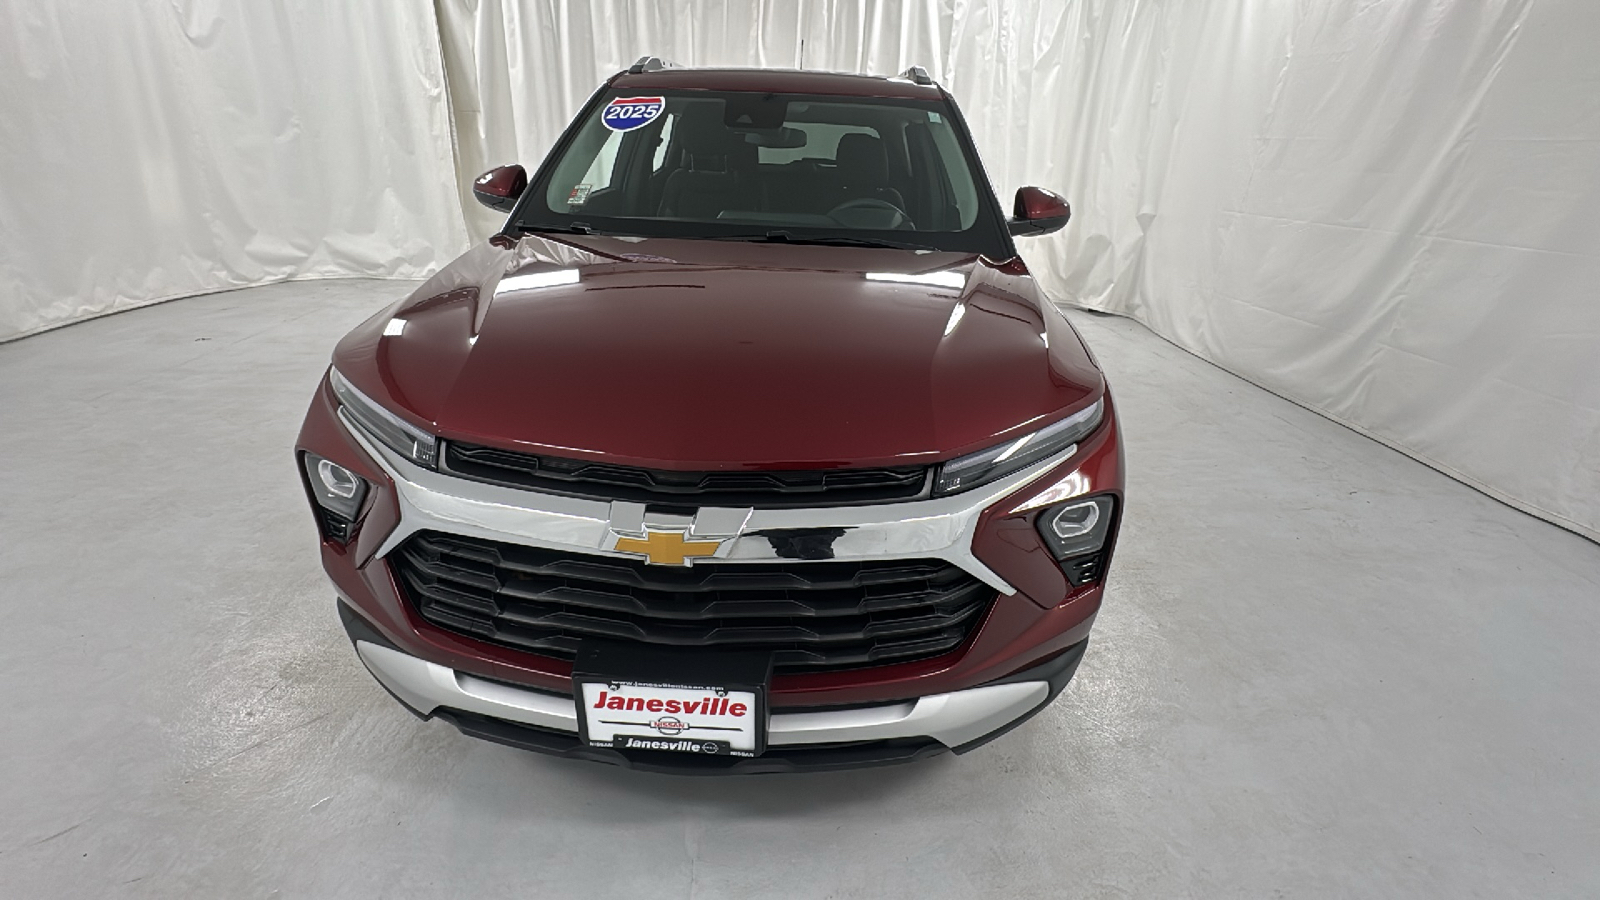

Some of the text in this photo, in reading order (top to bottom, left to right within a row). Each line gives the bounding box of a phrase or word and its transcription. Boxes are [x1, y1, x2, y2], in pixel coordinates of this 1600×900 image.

[606, 105, 659, 119] 2025
[593, 691, 748, 717] Janesville
[653, 721, 685, 729] NISSAN
[625, 737, 701, 753] Janesville
